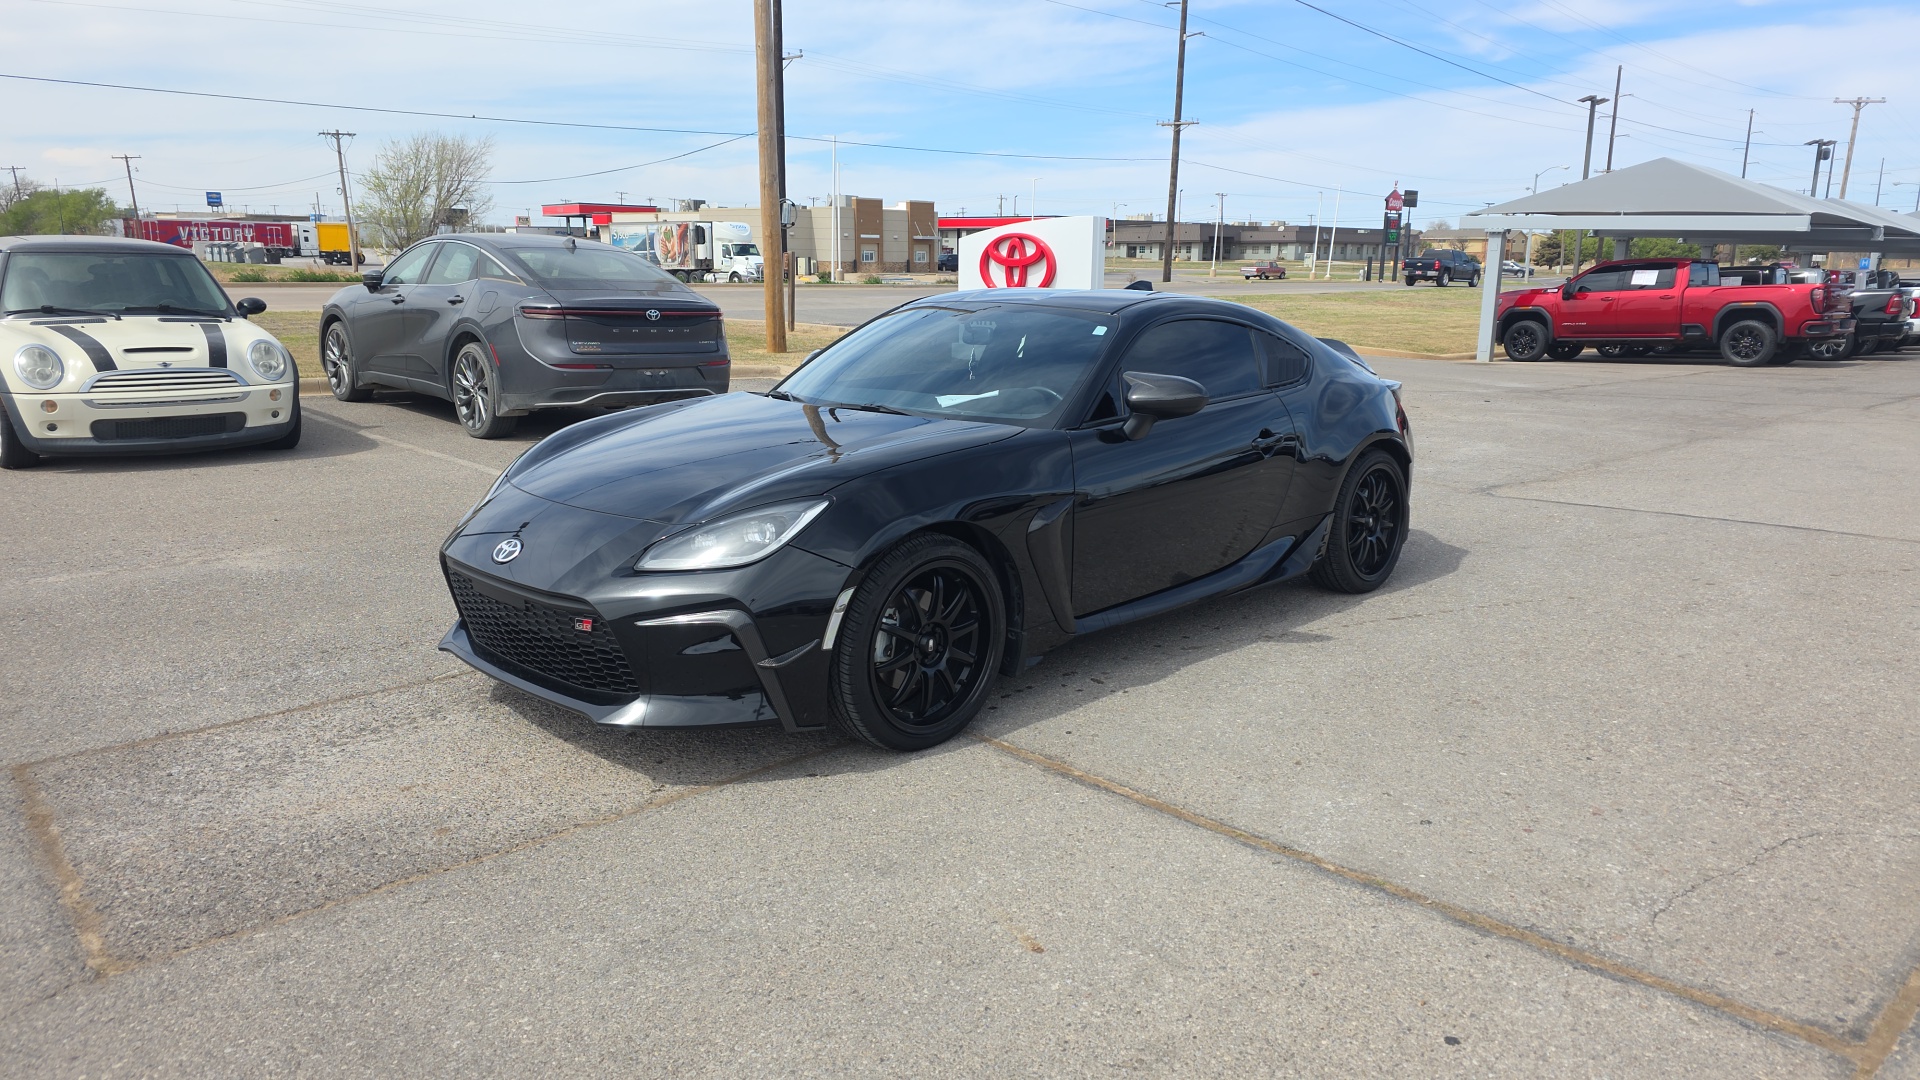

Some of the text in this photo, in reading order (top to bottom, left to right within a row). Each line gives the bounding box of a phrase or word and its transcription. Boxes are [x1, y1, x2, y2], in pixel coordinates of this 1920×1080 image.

[177, 225, 253, 241] VICTORY
[613, 230, 629, 241] Sysco
[1861, 259, 1869, 267] H
[576, 622, 591, 630] GR
